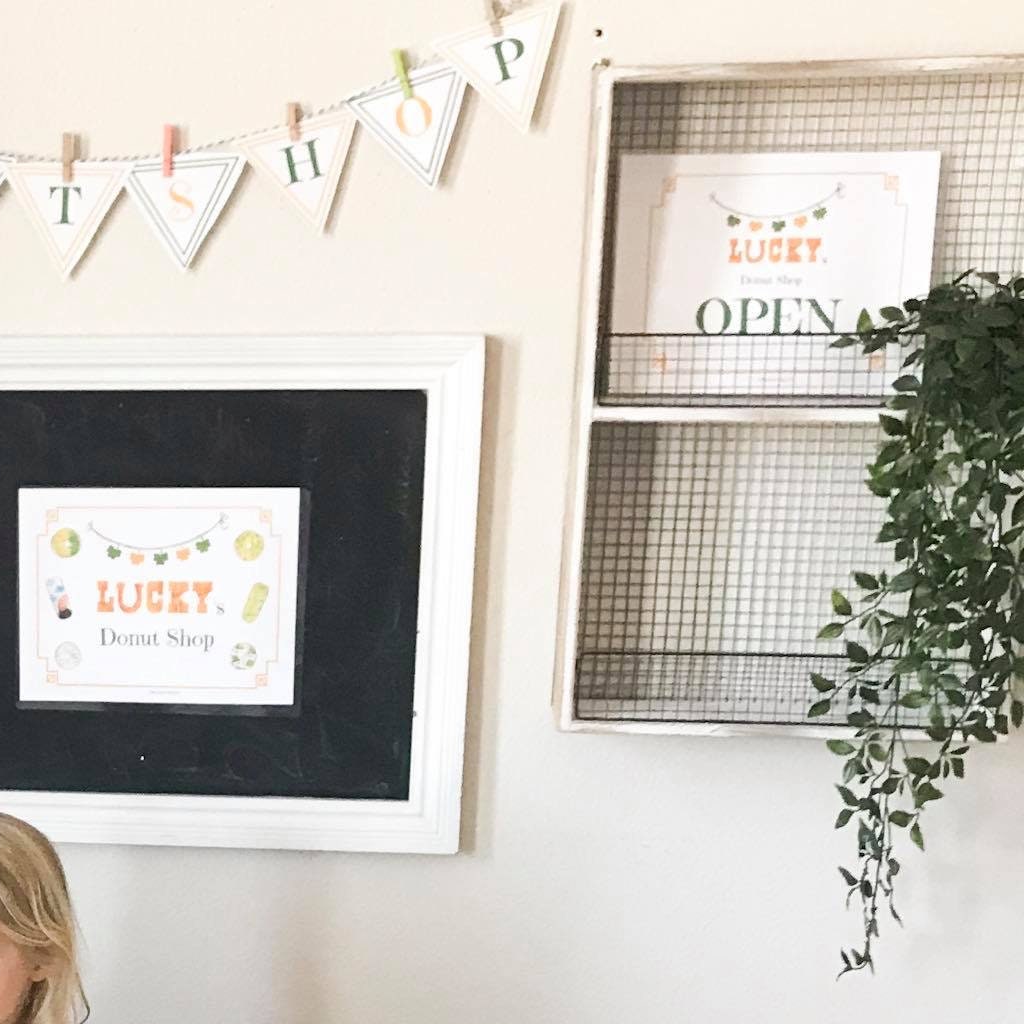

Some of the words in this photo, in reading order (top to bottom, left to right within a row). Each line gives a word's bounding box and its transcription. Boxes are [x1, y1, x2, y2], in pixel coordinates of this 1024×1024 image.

[695, 297, 843, 336] OPEN
[101, 627, 160, 647] Donut
[166, 627, 215, 653] Shop
